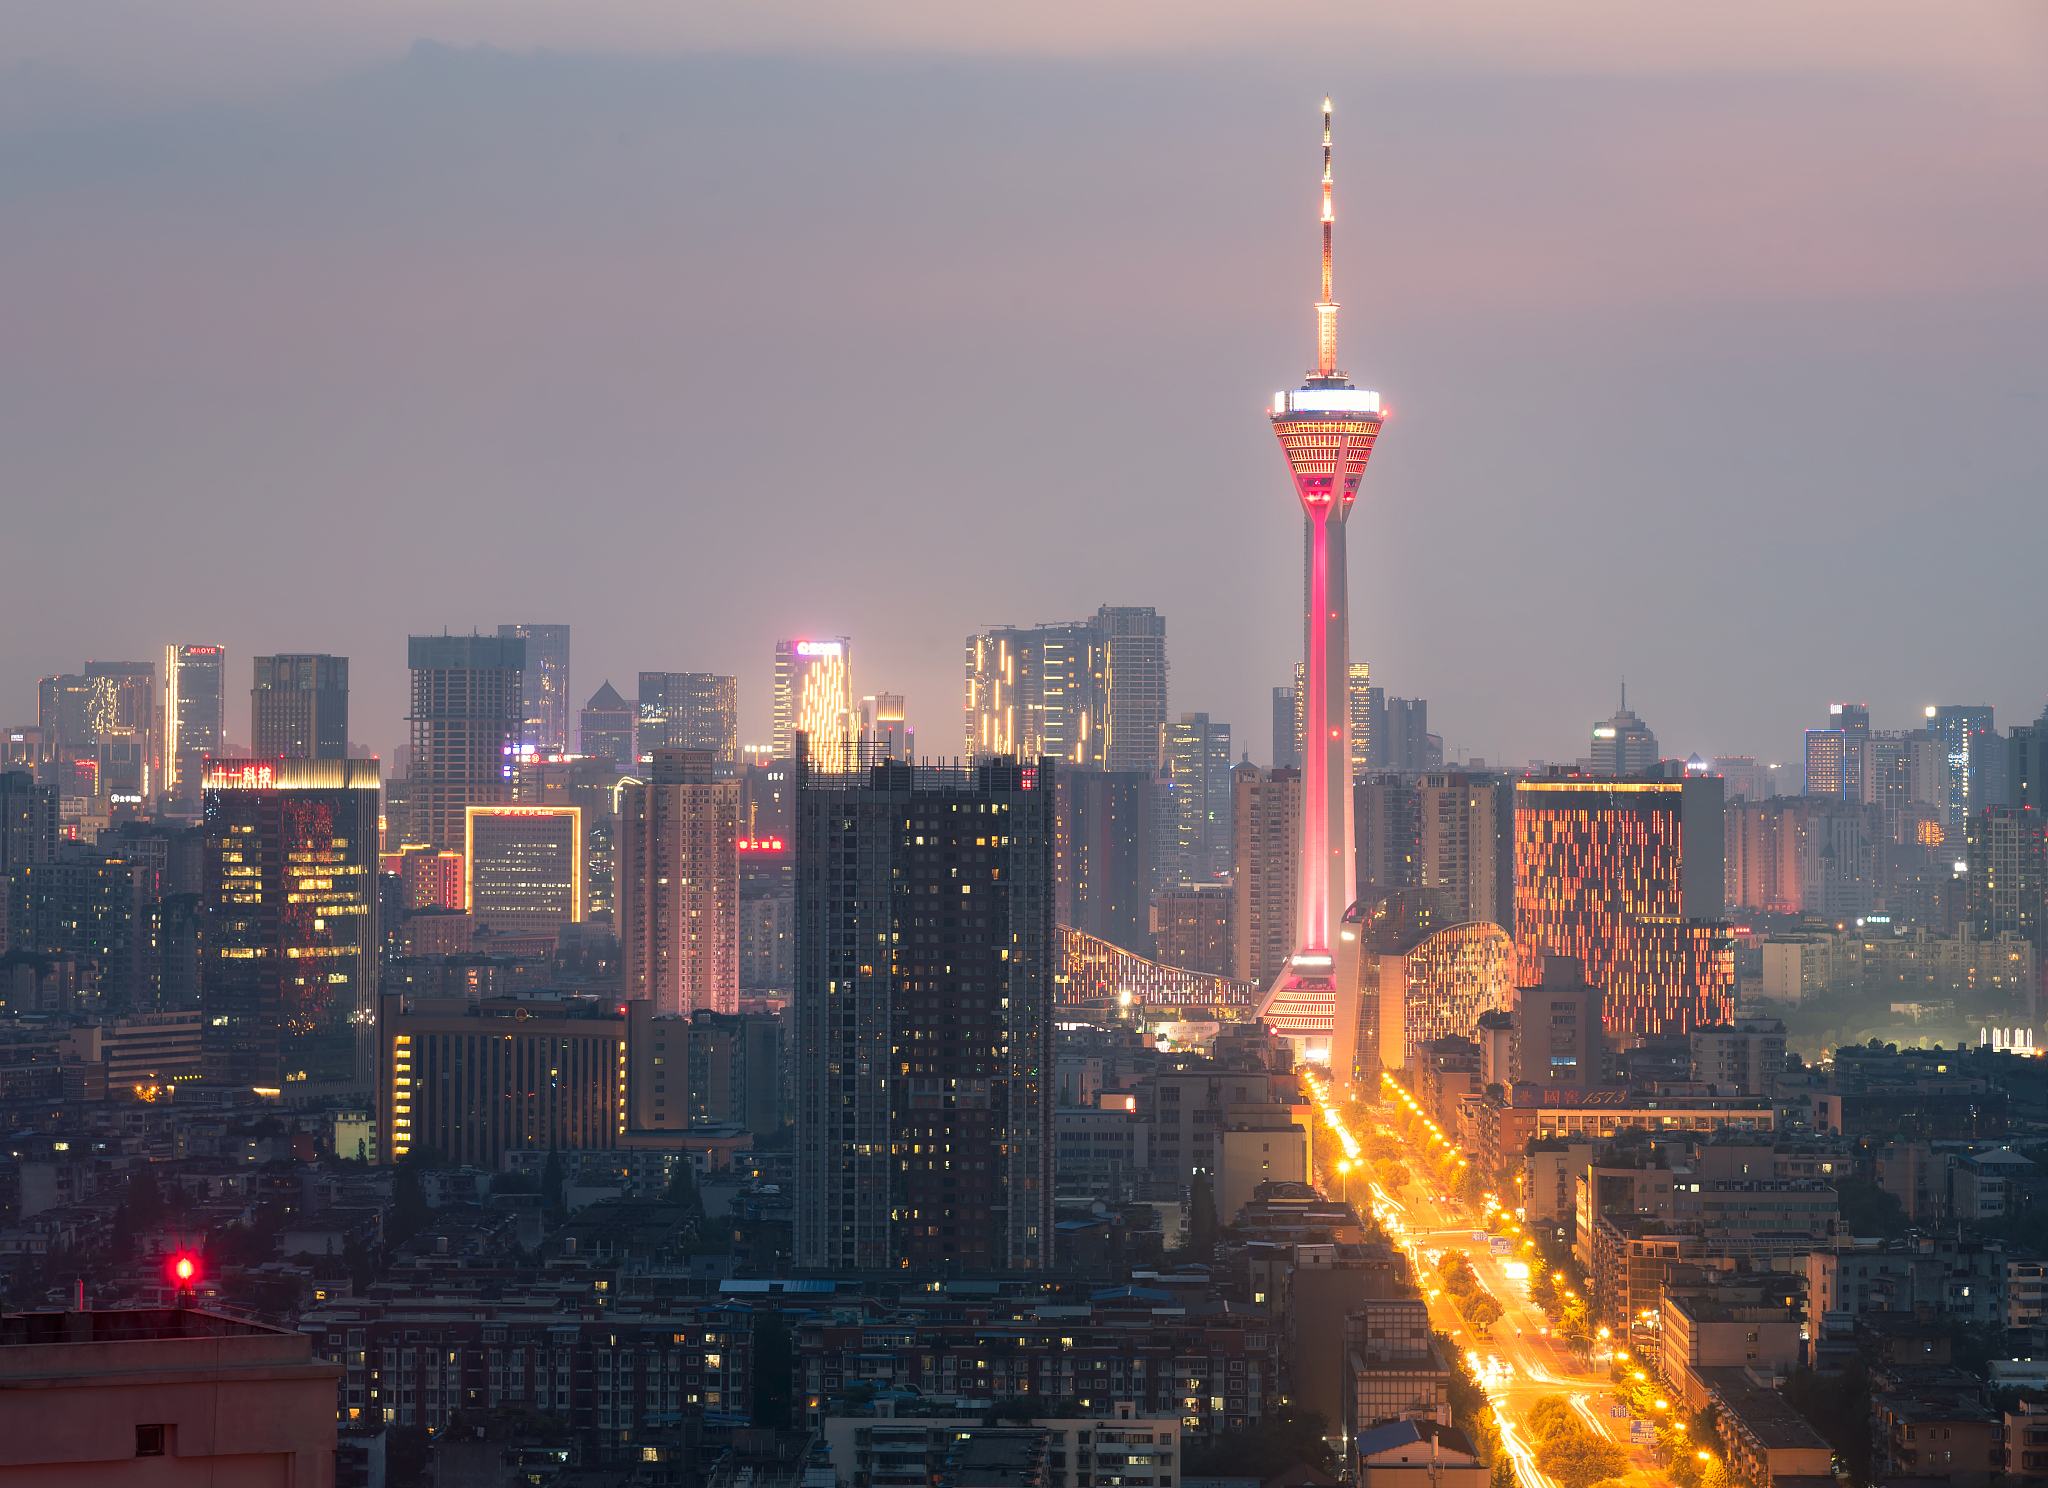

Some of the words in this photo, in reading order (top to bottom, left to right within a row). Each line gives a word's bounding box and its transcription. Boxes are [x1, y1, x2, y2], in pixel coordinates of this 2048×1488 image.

[515, 630, 531, 639] SAC
[190, 646, 216, 655] MAOYE
[1869, 729, 1909, 740] 世纪广场
[212, 766, 272, 784] 十一科技
